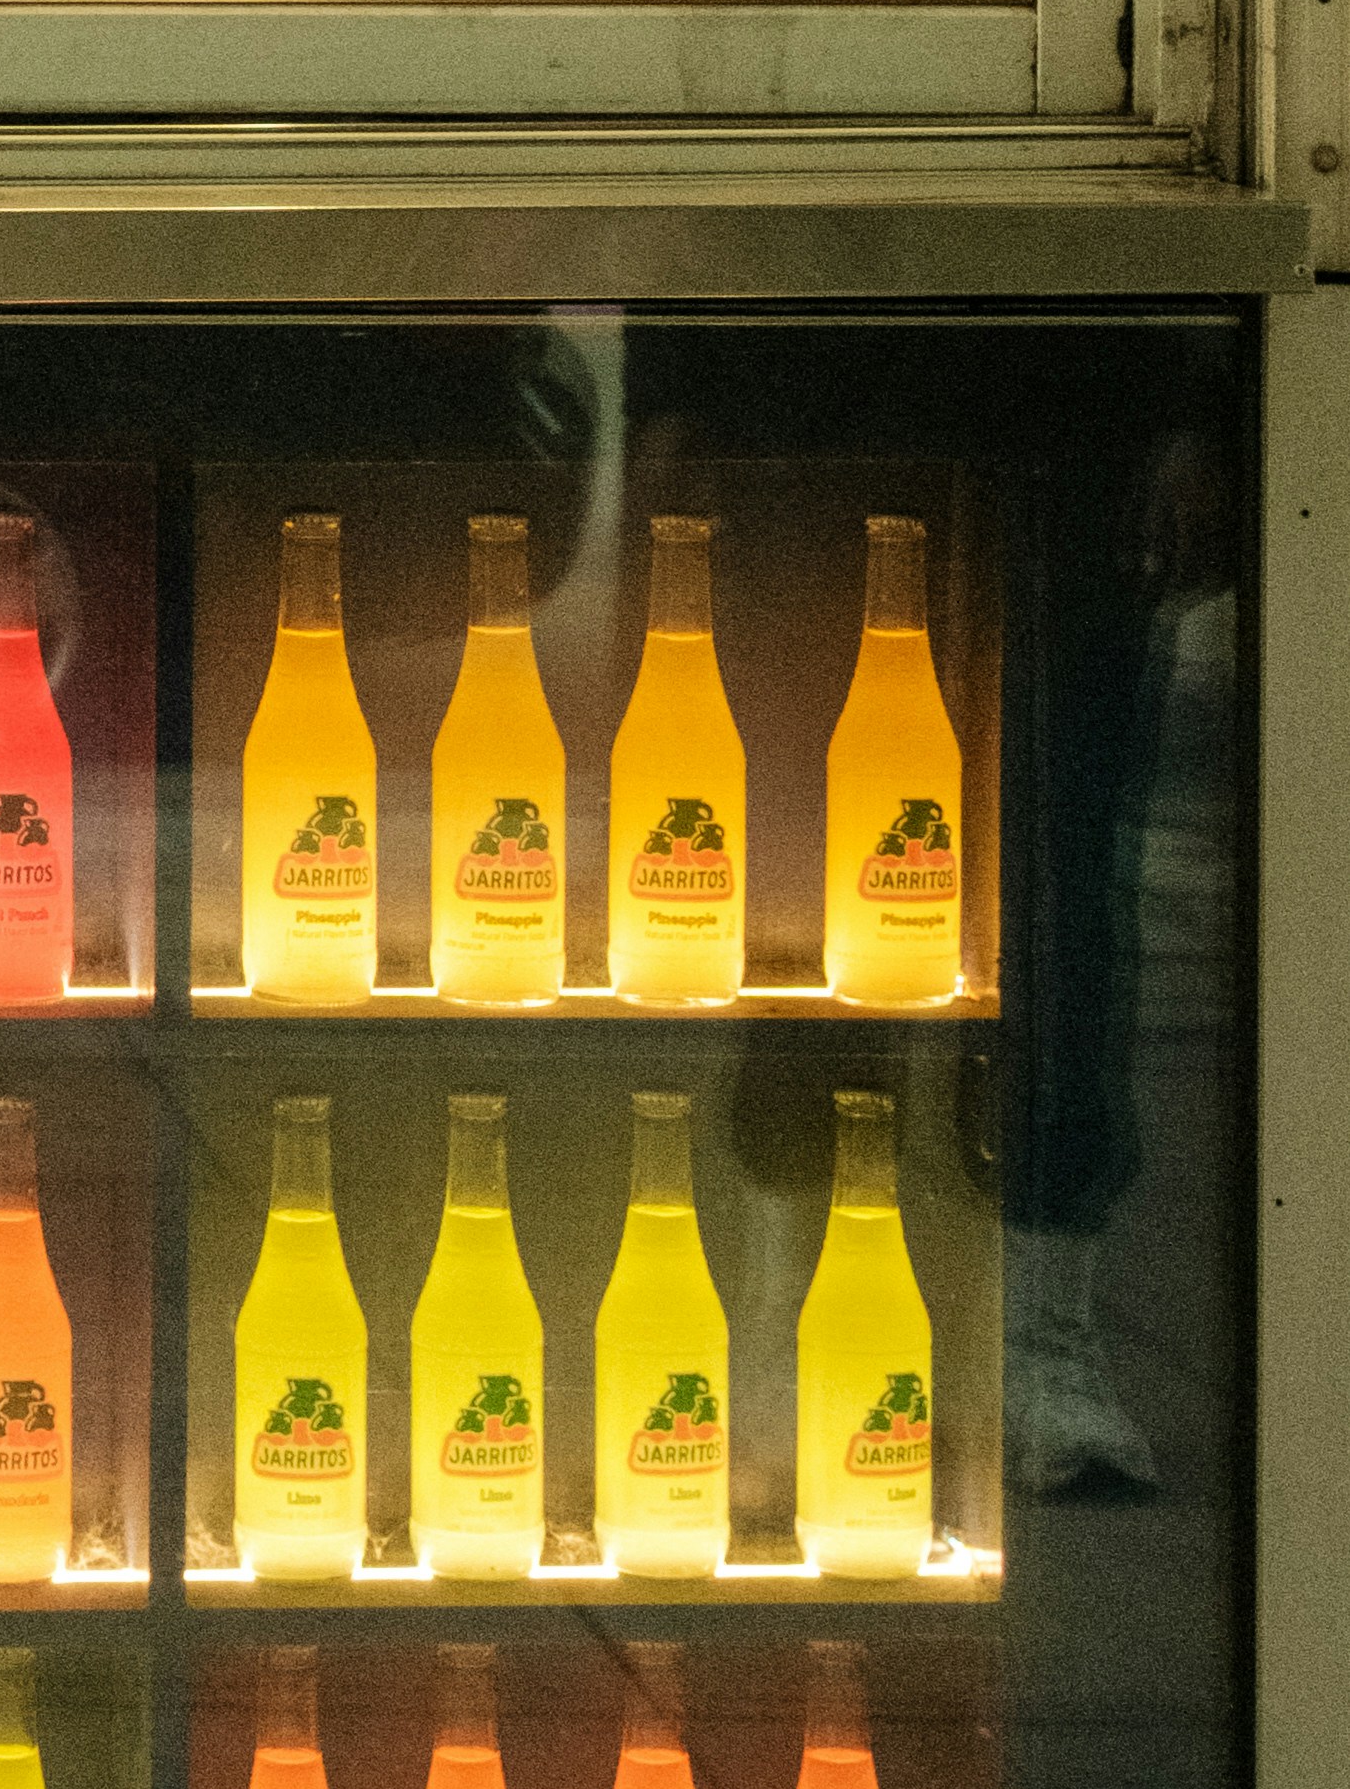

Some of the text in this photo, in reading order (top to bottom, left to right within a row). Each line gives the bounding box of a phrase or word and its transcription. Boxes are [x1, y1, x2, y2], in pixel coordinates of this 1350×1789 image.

[284, 867, 368, 886] JARRITOS
[464, 869, 551, 889] JARRITOS
[637, 869, 727, 889] JARRITOS
[869, 870, 953, 889] JARRITOS
[297, 910, 361, 925] Pineapple
[475, 912, 543, 928] Pineapple
[649, 912, 717, 928] Pineapple
[881, 913, 946, 928] Pineapple
[260, 1448, 346, 1468] JARRITOS
[450, 1444, 533, 1466] JARRITOS
[637, 1442, 720, 1463] JARRITOS
